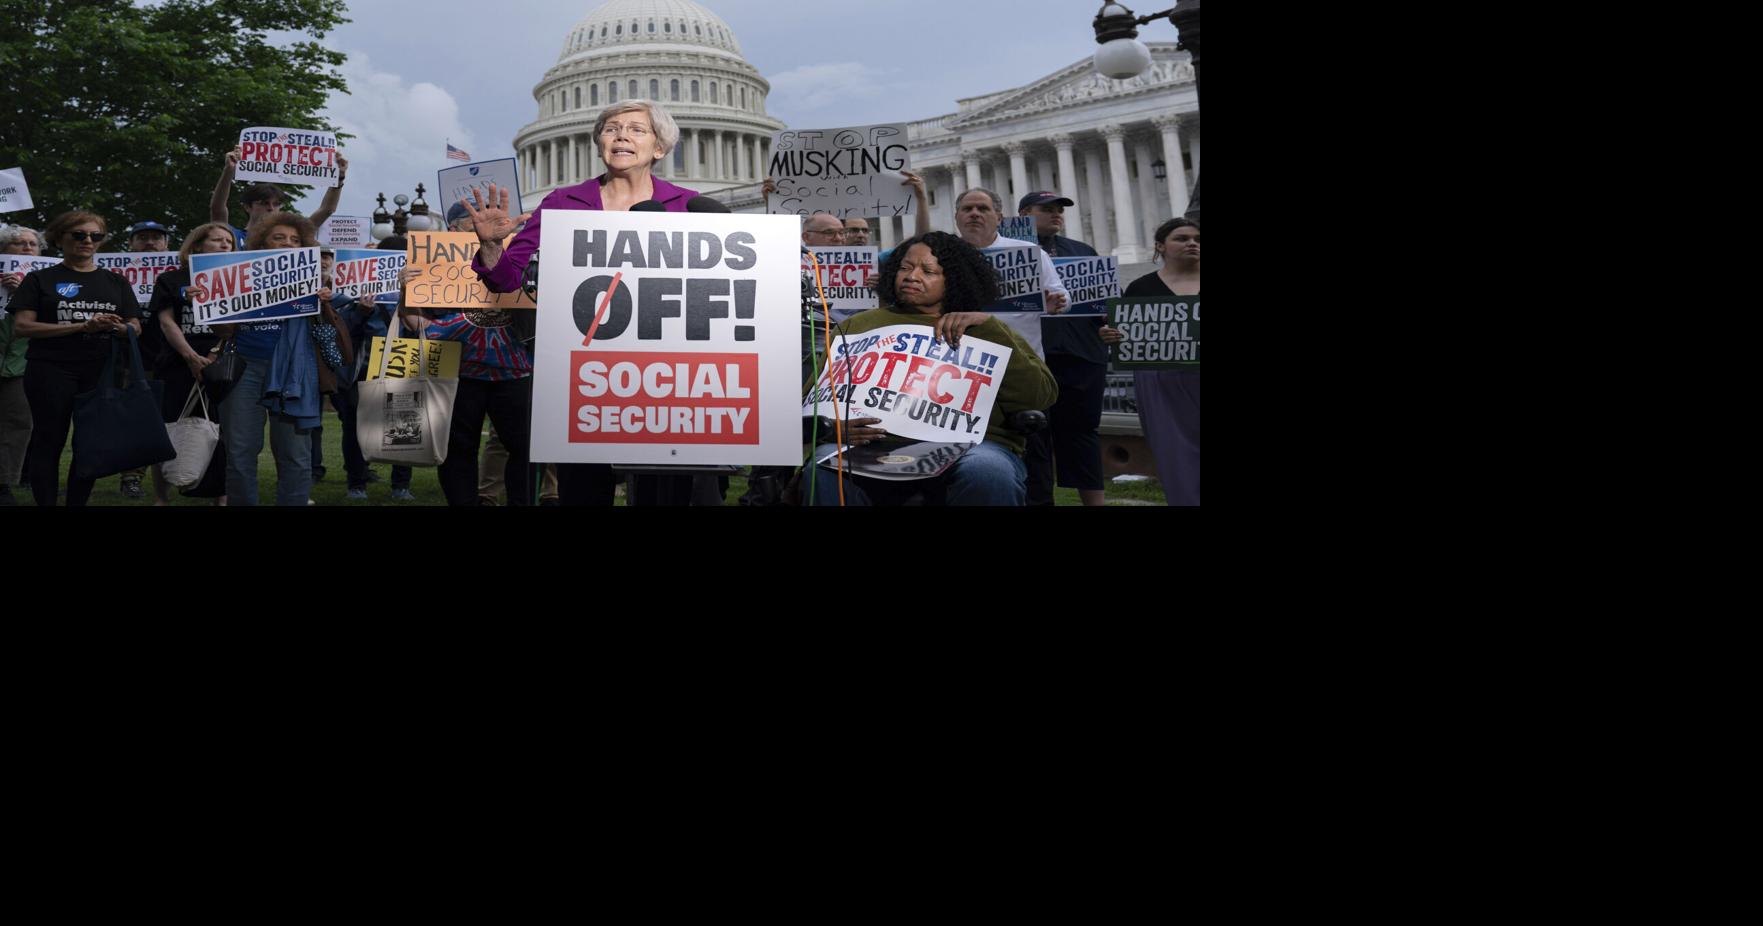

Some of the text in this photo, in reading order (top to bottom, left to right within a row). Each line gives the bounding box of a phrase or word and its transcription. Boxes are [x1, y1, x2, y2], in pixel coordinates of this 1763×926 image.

[243, 131, 277, 142] STOP
[288, 133, 335, 148] STEAL!!
[777, 127, 900, 150] STOP
[241, 141, 336, 167] PROTECT
[769, 144, 908, 177] MUSKING
[239, 160, 337, 179] SOCIAL SECURITY.
[775, 176, 873, 197] Social
[98, 257, 130, 268] STOP
[572, 229, 757, 271] HANDS
[815, 251, 872, 265] STEAL!!
[194, 249, 317, 304] SAVE SOCIAL
[253, 264, 319, 292] SECURITY.
[335, 258, 378, 287] SAVE
[1064, 272, 1117, 291] ECURITY.
[199, 299, 228, 321] IT'S
[231, 292, 262, 313] OUR
[265, 278, 319, 305] MONEY!
[361, 281, 383, 297] OUR
[57, 300, 117, 311] Activists
[572, 274, 757, 342] OFF!
[1114, 302, 1188, 323] HANDS
[1117, 321, 1193, 342] SOCIAL
[835, 332, 1000, 376] STOP THE STEAL!!
[1118, 341, 1200, 361] SECURI
[578, 360, 751, 399] SOCIAL
[817, 351, 992, 414] PROTECT
[576, 404, 751, 435] SECURITY
[863, 386, 981, 435] SECURITY.
